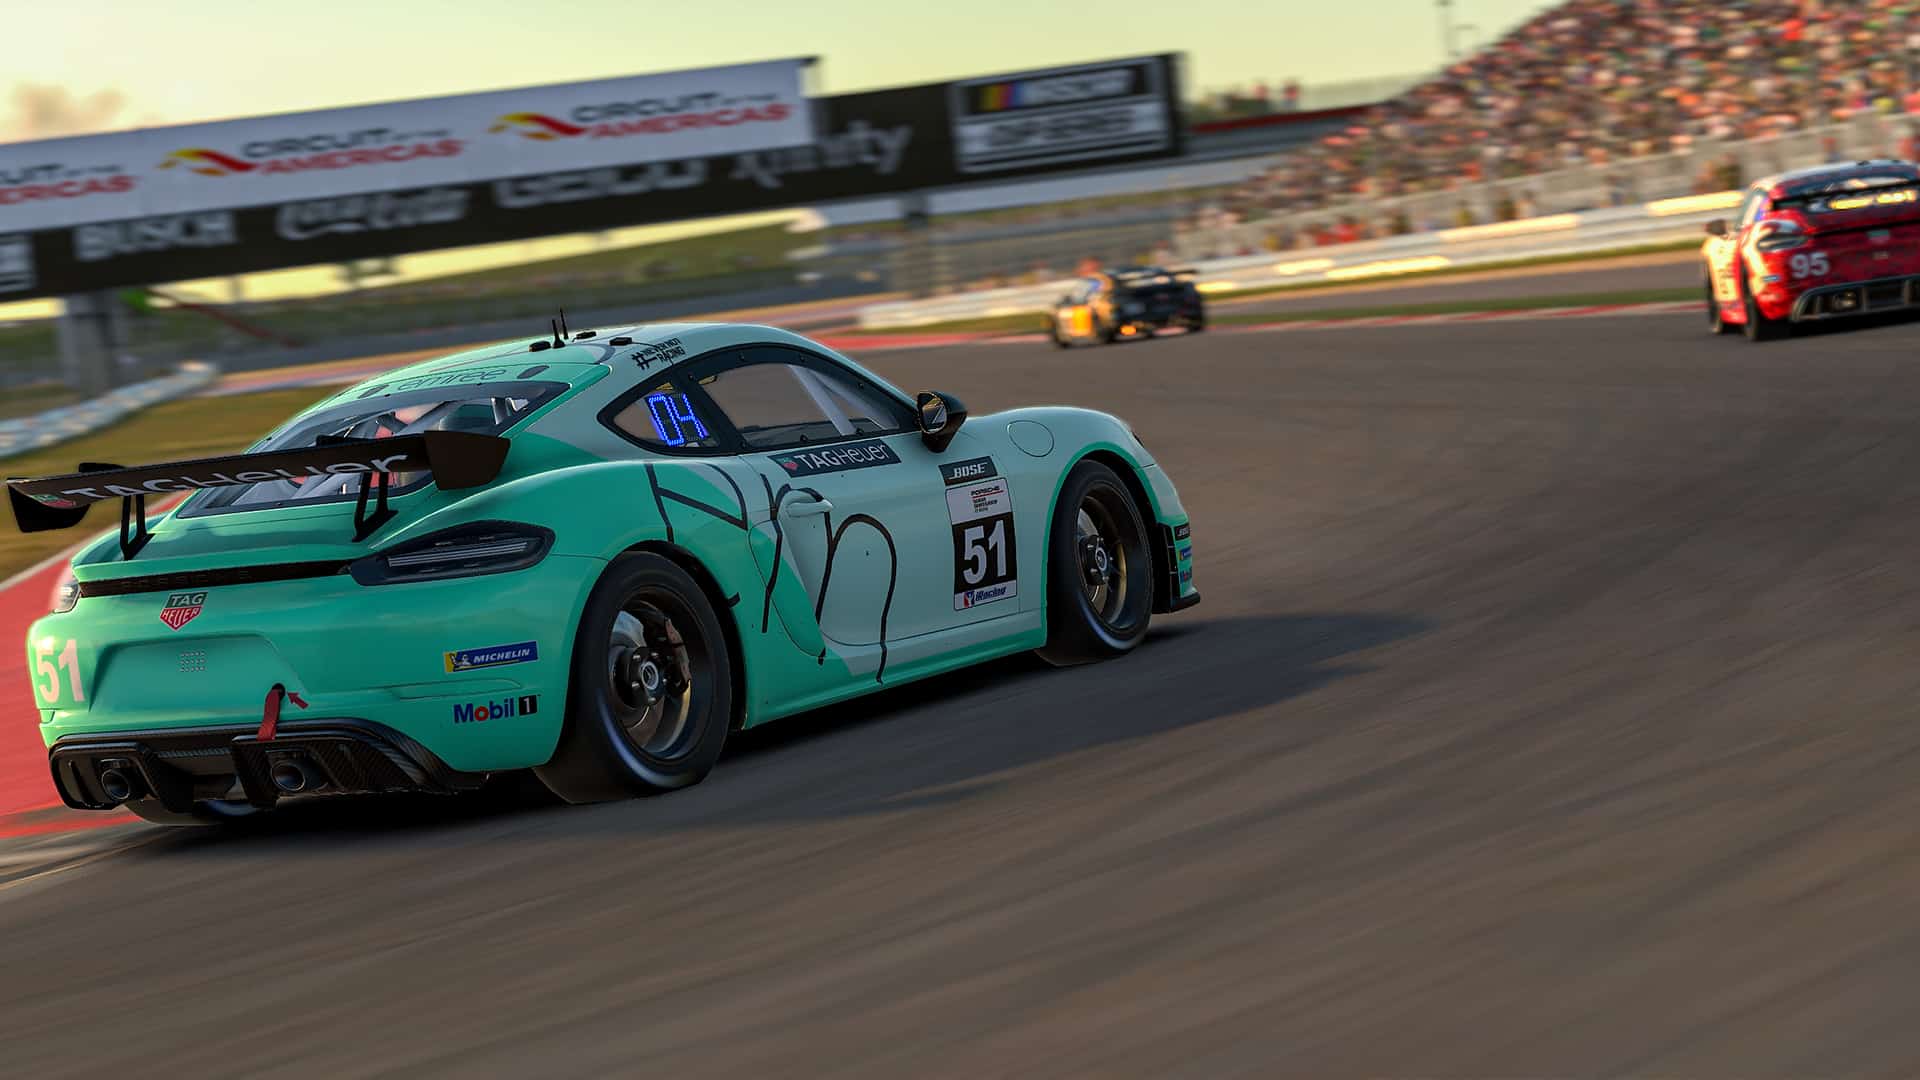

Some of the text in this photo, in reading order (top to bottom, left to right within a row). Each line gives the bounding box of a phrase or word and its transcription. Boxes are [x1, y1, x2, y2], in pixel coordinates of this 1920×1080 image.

[590, 103, 794, 138] AMERICAS
[242, 128, 390, 158] CIRCUIT
[258, 138, 468, 175] AMERICAS
[1790, 251, 1830, 278] 95
[950, 462, 988, 480] BOSE
[963, 520, 1007, 585] 51
[171, 593, 204, 606] TAG
[162, 607, 200, 628] HEUER
[473, 648, 530, 664] MICHELIN
[34, 638, 85, 703] 51
[453, 697, 515, 724] Mobil
